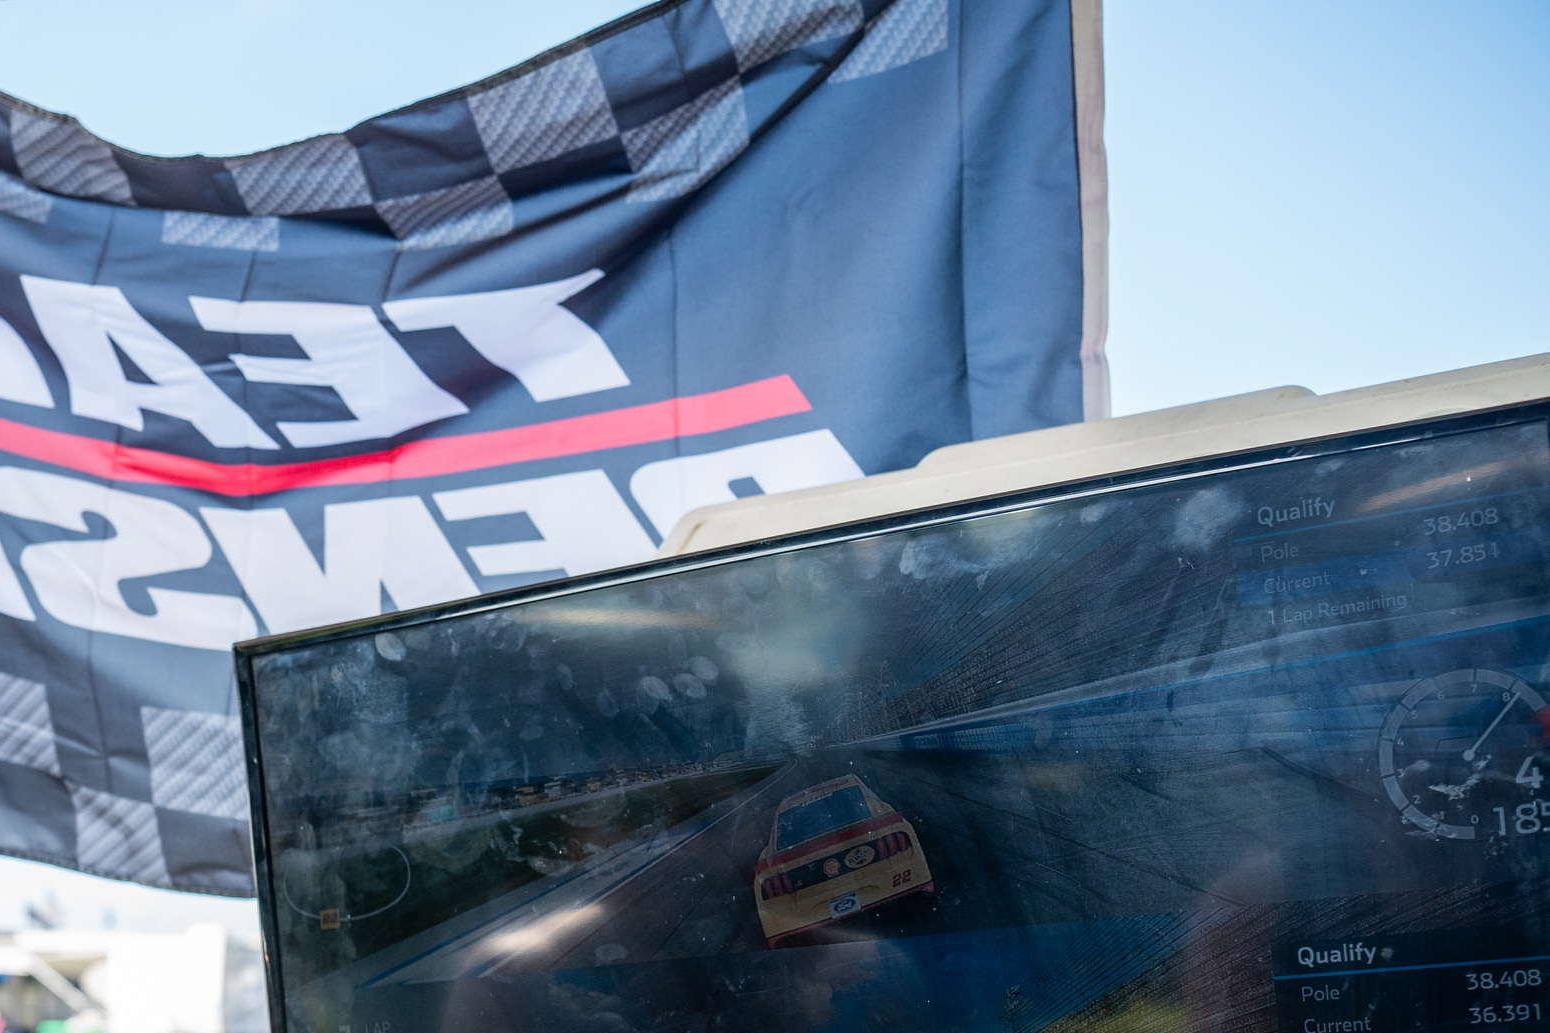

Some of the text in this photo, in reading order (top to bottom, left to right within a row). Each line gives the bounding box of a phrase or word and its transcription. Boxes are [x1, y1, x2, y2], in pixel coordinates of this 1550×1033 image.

[1257, 496, 1336, 527] Qualify
[1261, 507, 1499, 563] Pole 38.408
[1263, 571, 1331, 596] Current
[1282, 606, 1313, 624] Lap
[1318, 592, 1407, 619] Remaining
[1515, 756, 1545, 788] 4
[892, 869, 912, 888] 22
[1297, 942, 1377, 967] Qualify
[1301, 969, 1542, 1002] Pole 38.408
[1469, 1003, 1541, 1025] 36.391
